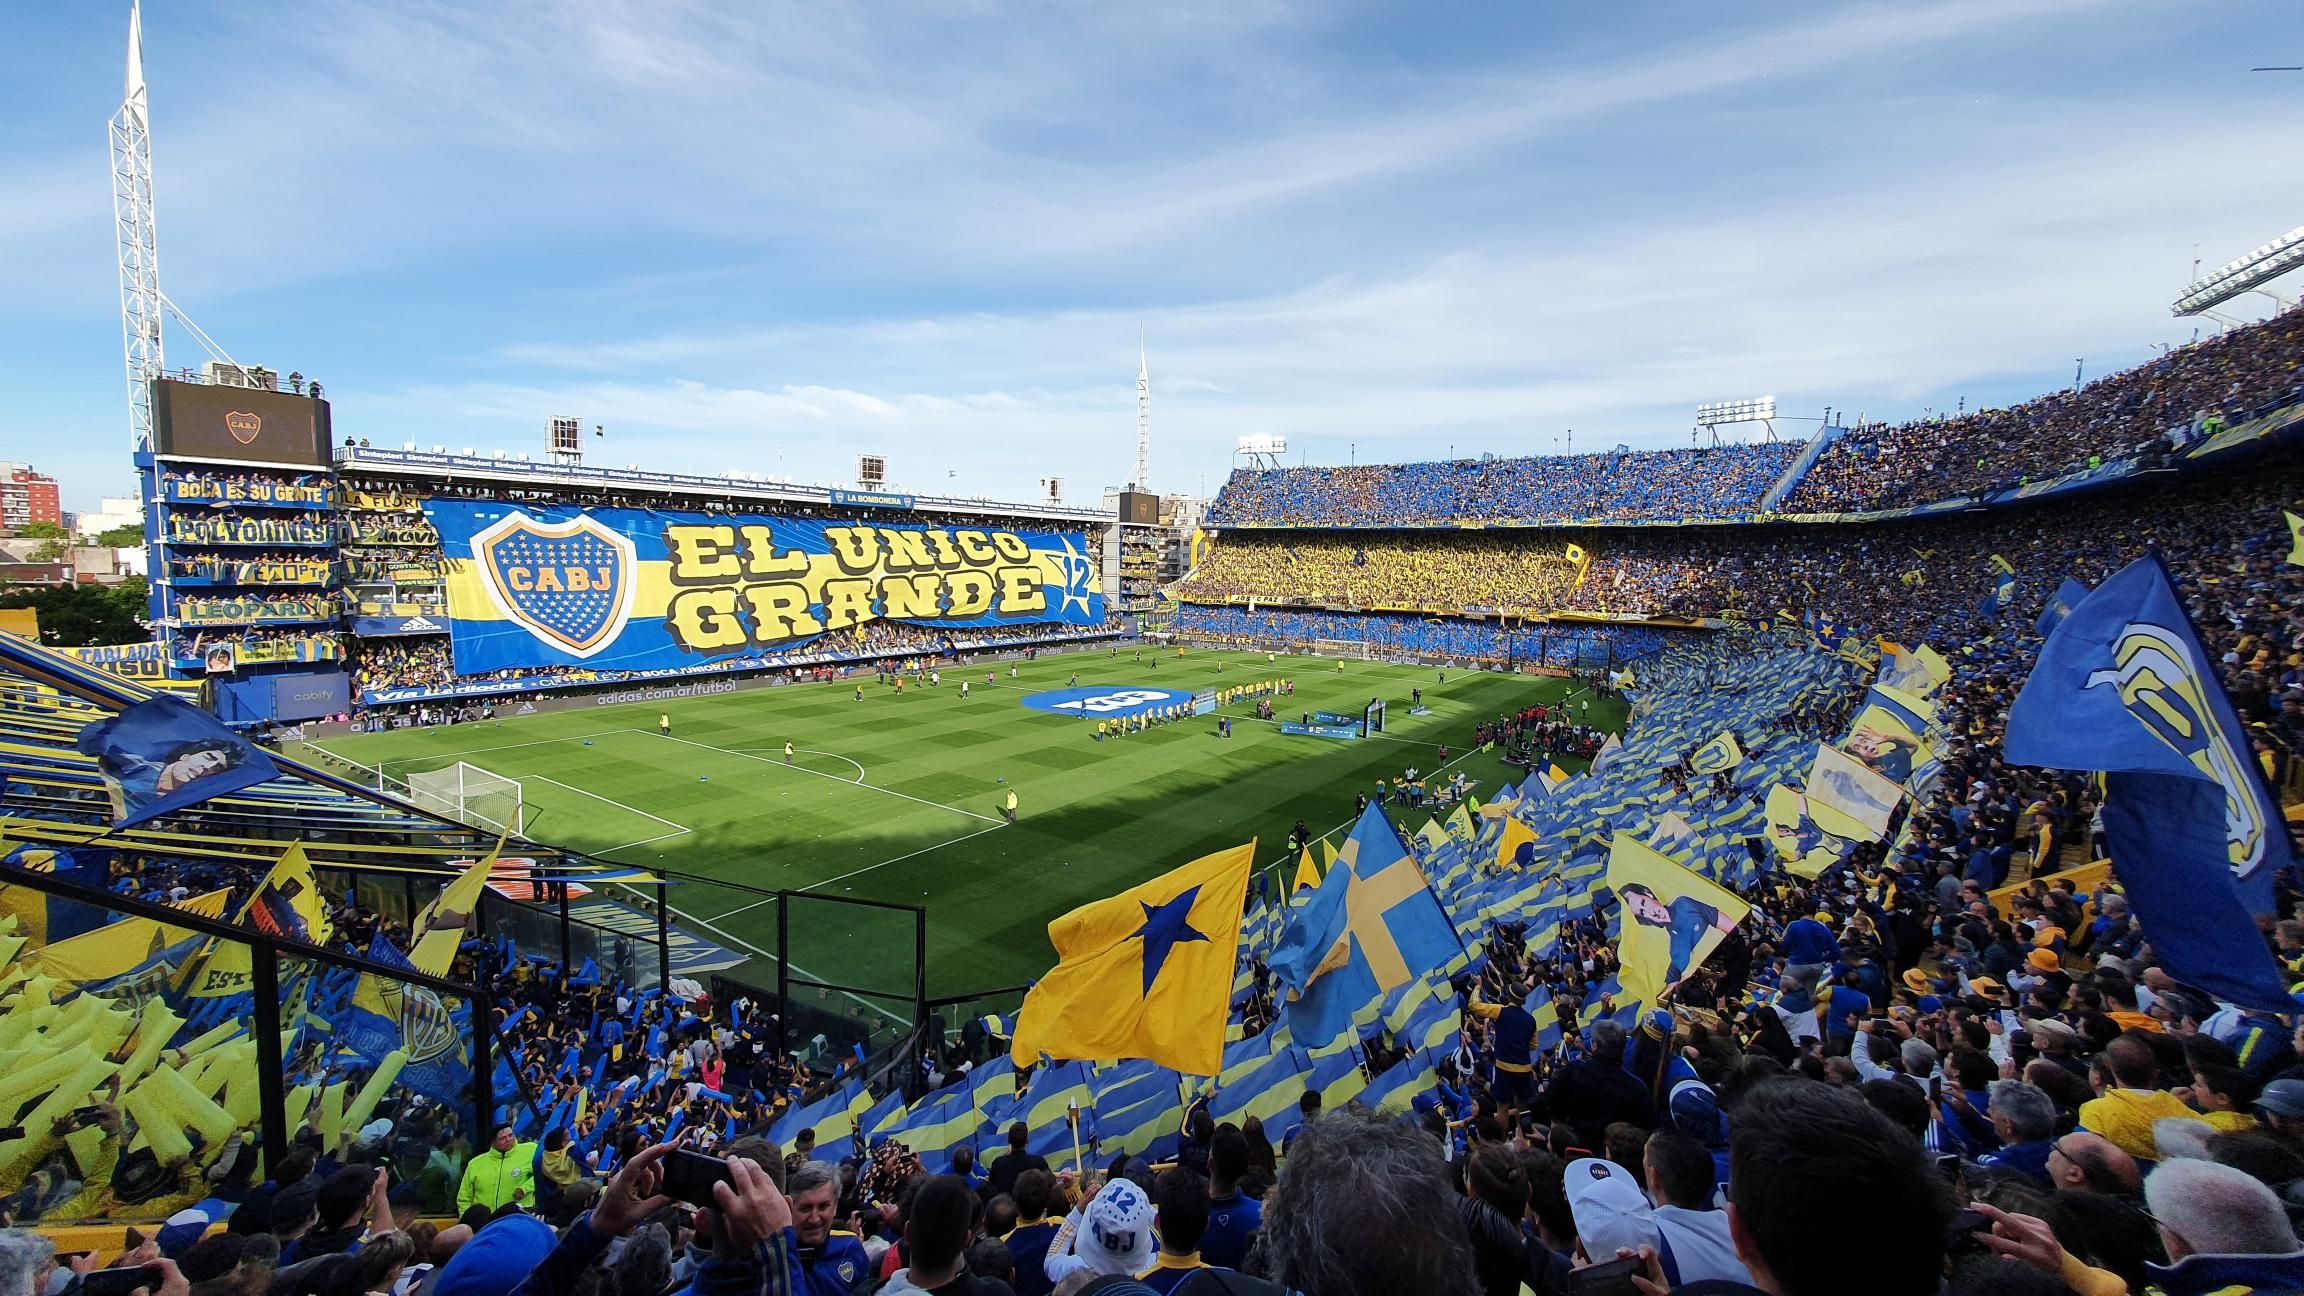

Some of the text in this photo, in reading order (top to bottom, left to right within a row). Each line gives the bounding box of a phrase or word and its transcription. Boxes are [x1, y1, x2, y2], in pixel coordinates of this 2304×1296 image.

[358, 450, 403, 460] Sinteplast
[406, 453, 448, 463] Sinteplast
[452, 457, 492, 467] Sinteplast
[494, 461, 531, 470] Sinteplast
[847, 494, 902, 505] LA BOMBONERA
[664, 524, 1032, 586] EL UNICO
[508, 566, 611, 592] CABJ
[1063, 555, 1094, 600] 12
[664, 566, 1048, 655] GRANDE
[400, 623, 442, 632] adidas
[641, 668, 678, 678] BOCA
[680, 663, 727, 676] JUNIOR
[761, 656, 785, 667] LA
[293, 689, 333, 702] cabify
[597, 681, 737, 705] adidas.com.ar/futbol
[1107, 1186, 1136, 1215] 12
[1091, 1220, 1136, 1252] ABJ
